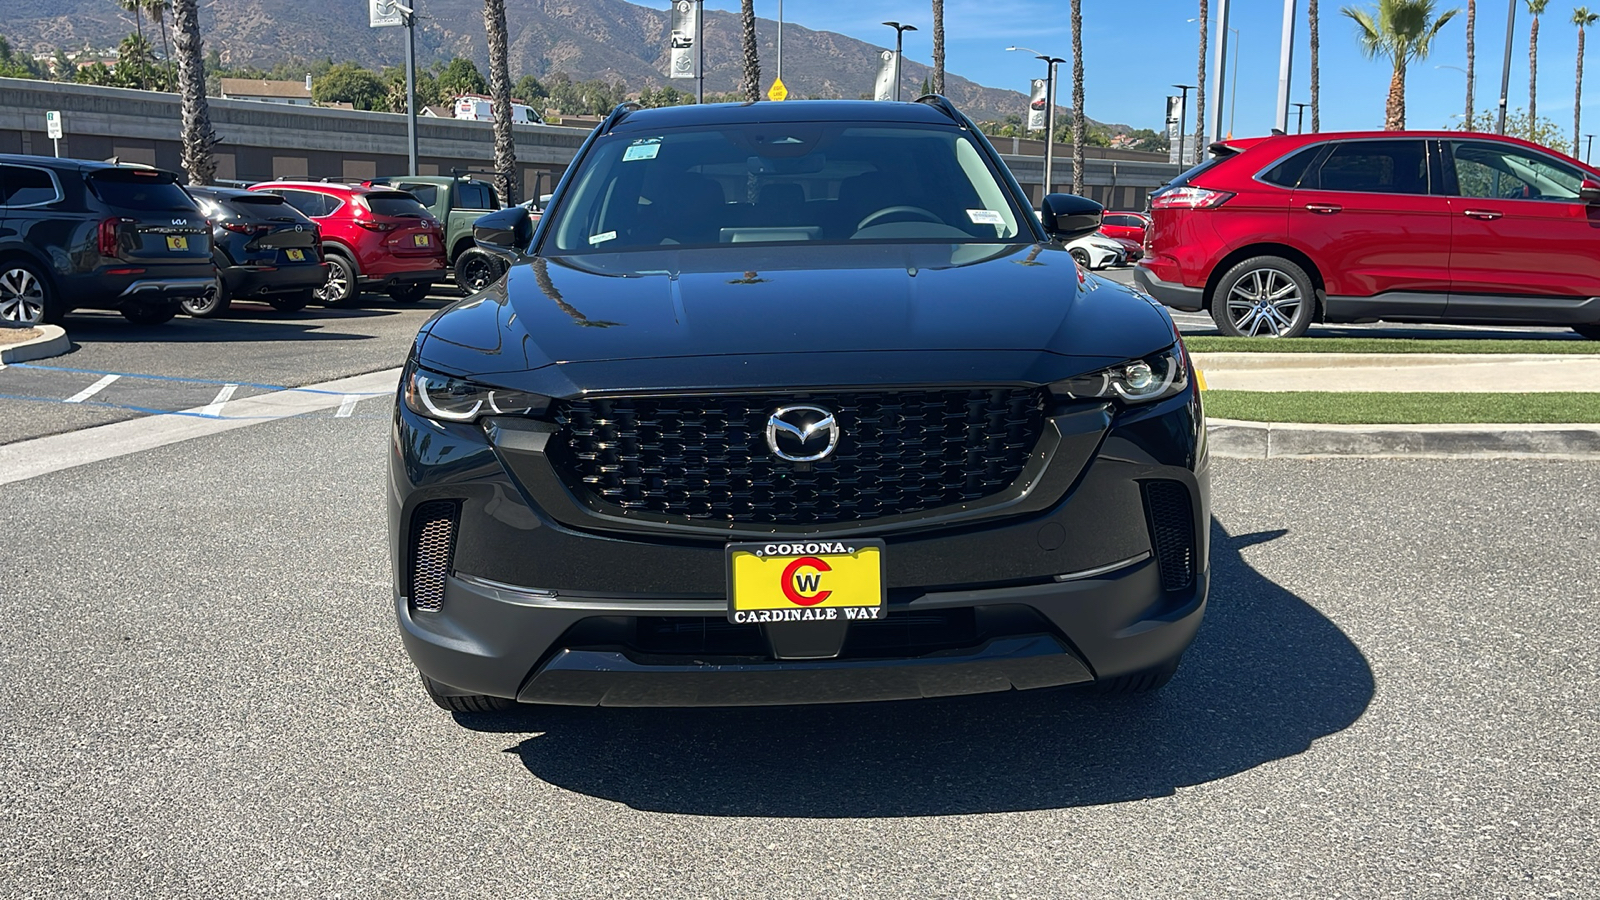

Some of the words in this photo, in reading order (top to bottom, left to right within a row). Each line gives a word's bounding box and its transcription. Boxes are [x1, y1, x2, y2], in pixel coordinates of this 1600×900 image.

[764, 542, 846, 555] CORONA
[781, 556, 832, 606] C
[796, 573, 822, 592] W
[734, 608, 837, 623] CARDINALE
[843, 607, 881, 619] WAY
